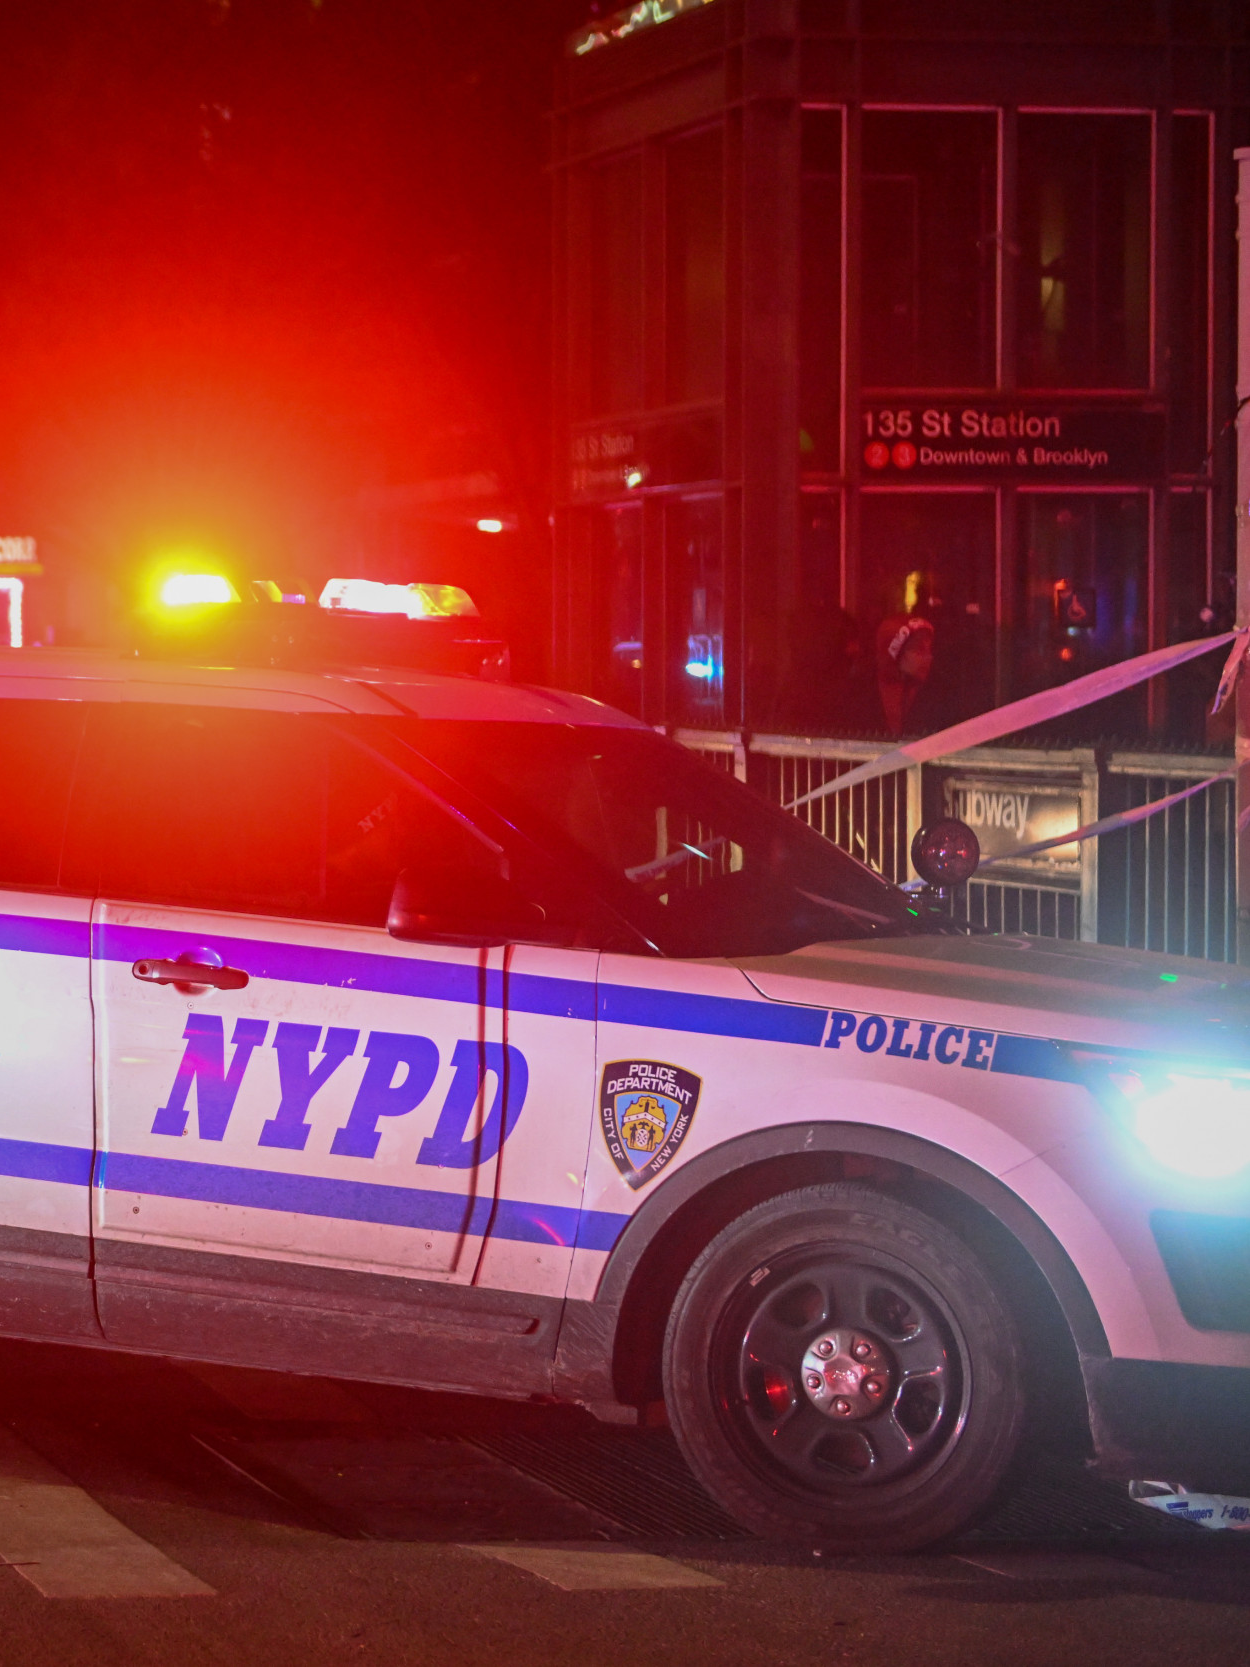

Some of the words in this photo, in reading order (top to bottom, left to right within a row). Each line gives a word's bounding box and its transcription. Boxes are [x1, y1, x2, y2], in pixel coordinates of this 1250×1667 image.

[861, 411, 912, 437] 135
[922, 410, 951, 437] St
[961, 410, 1061, 437] Station
[920, 447, 1010, 465] Downtown
[1016, 447, 1028, 465] &
[1034, 447, 1108, 469] Brooklyn
[824, 1011, 995, 1071] POLICE
[150, 1012, 529, 1170] NYPD
[607, 1077, 692, 1105] DEPARTMENT
[629, 1064, 677, 1083] POLICE
[603, 1107, 617, 1139] CITY
[610, 1142, 625, 1160] OF
[650, 1144, 673, 1172] NEW
[669, 1113, 690, 1144] YORK
